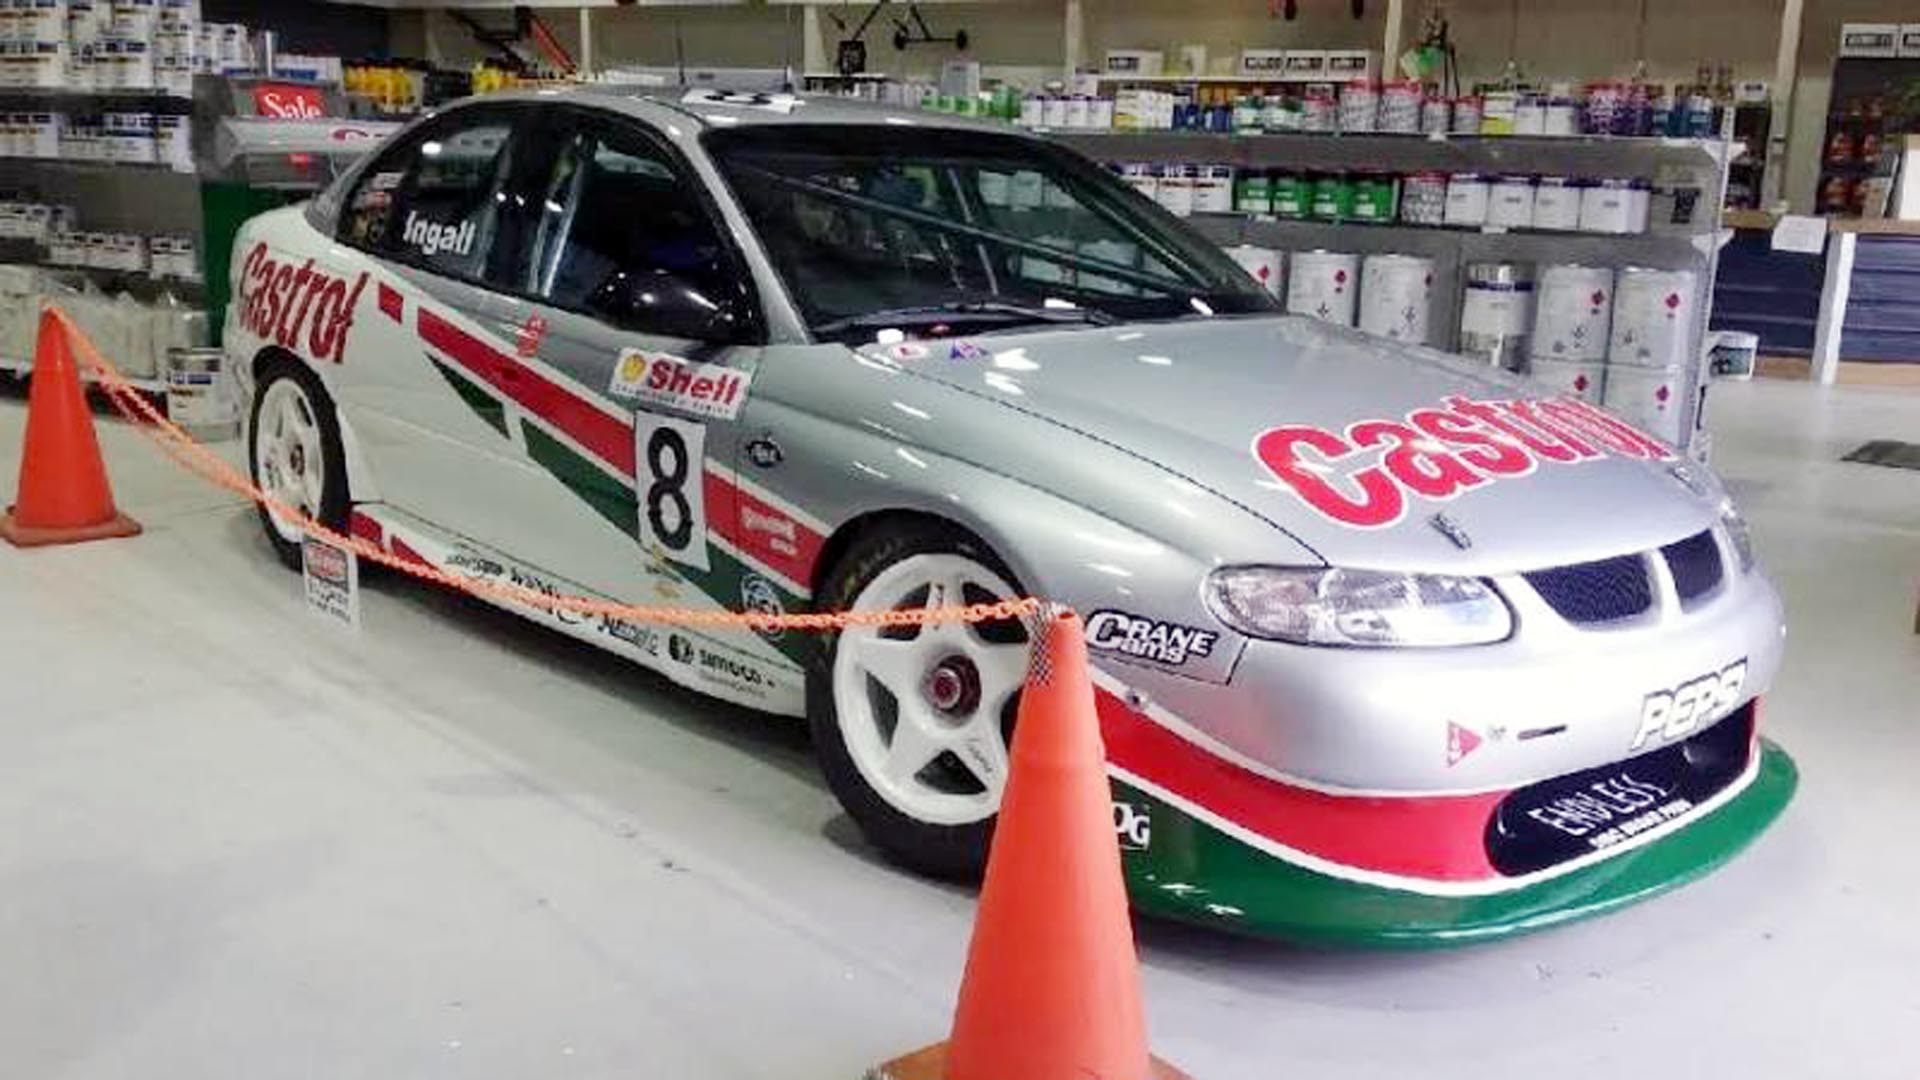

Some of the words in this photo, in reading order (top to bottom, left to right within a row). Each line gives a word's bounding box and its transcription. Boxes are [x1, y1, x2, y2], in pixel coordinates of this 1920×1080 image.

[264, 92, 321, 120] Sale
[403, 210, 476, 255] Ingall
[239, 242, 370, 363] Castrol
[650, 358, 741, 406] Shell
[1253, 395, 1677, 529] Castrol
[647, 426, 693, 551] 8
[1085, 611, 1217, 656] CRANE
